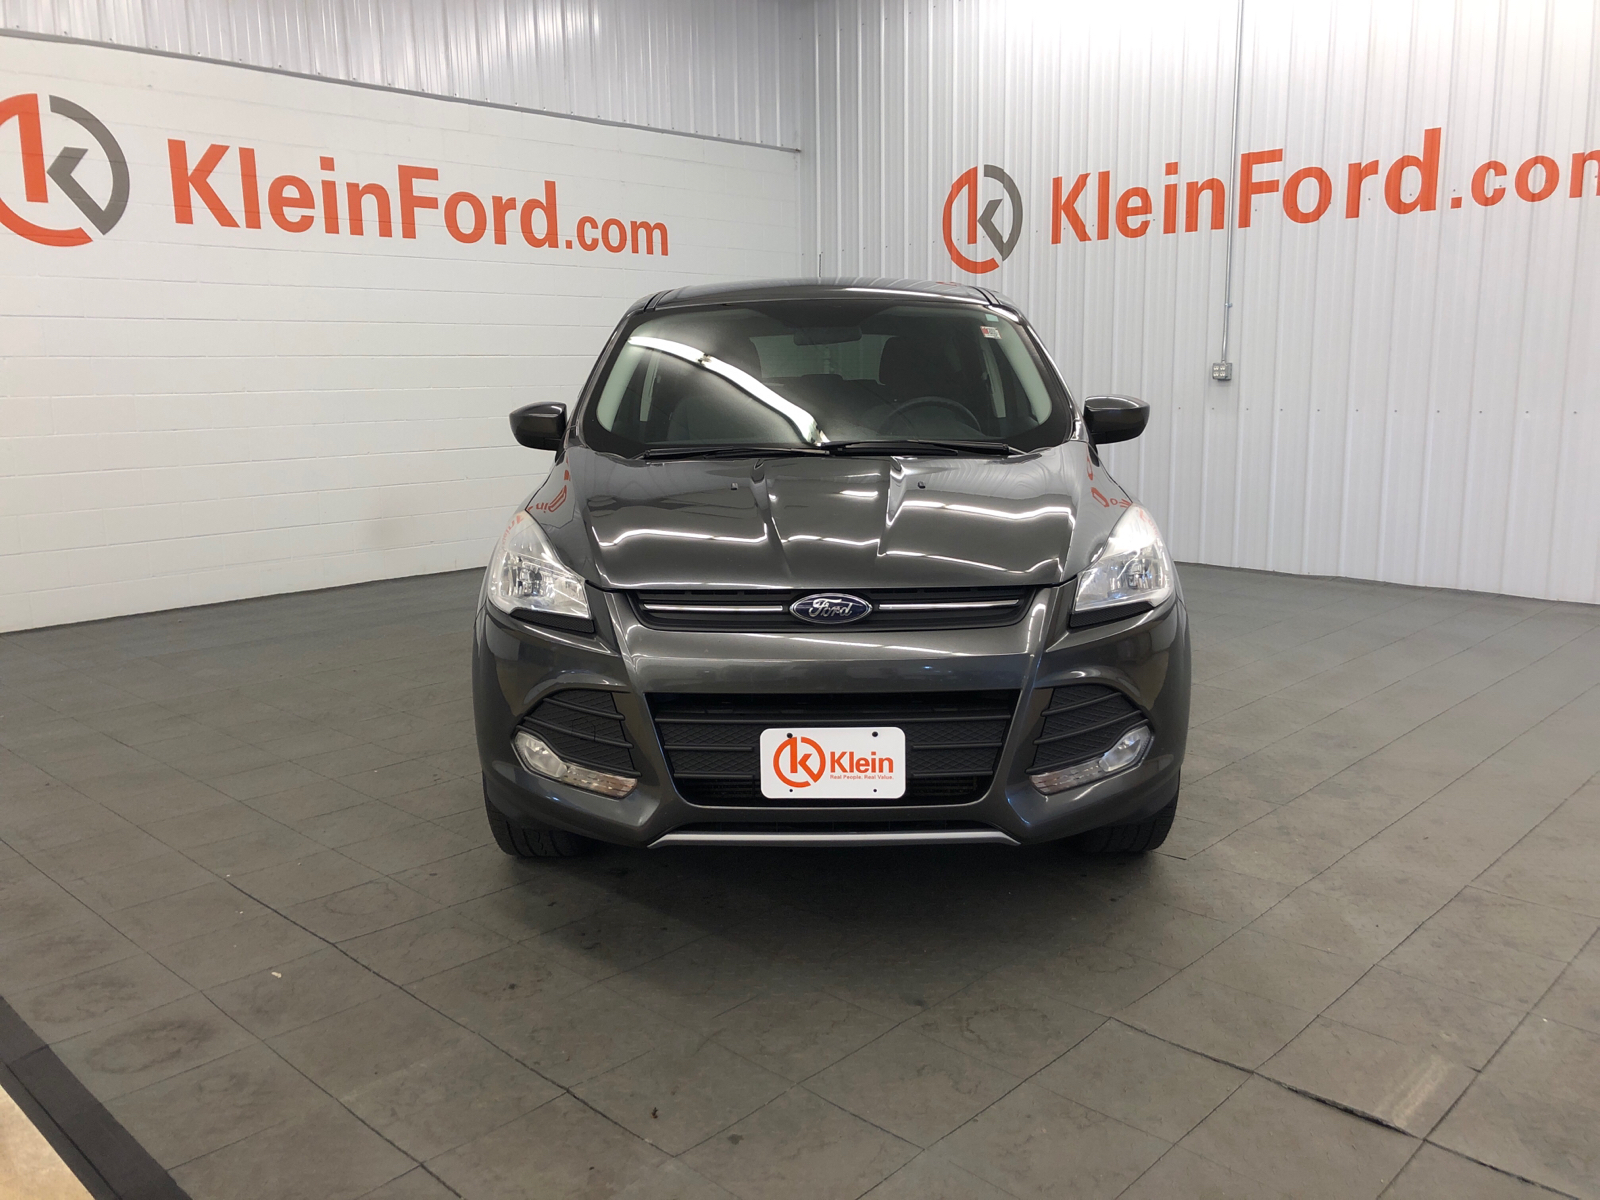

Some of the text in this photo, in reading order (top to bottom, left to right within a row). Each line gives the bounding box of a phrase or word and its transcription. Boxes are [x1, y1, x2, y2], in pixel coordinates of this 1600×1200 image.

[168, 138, 669, 257] KleinFord.com
[808, 598, 853, 617] Ford
[830, 751, 894, 773] Klein
